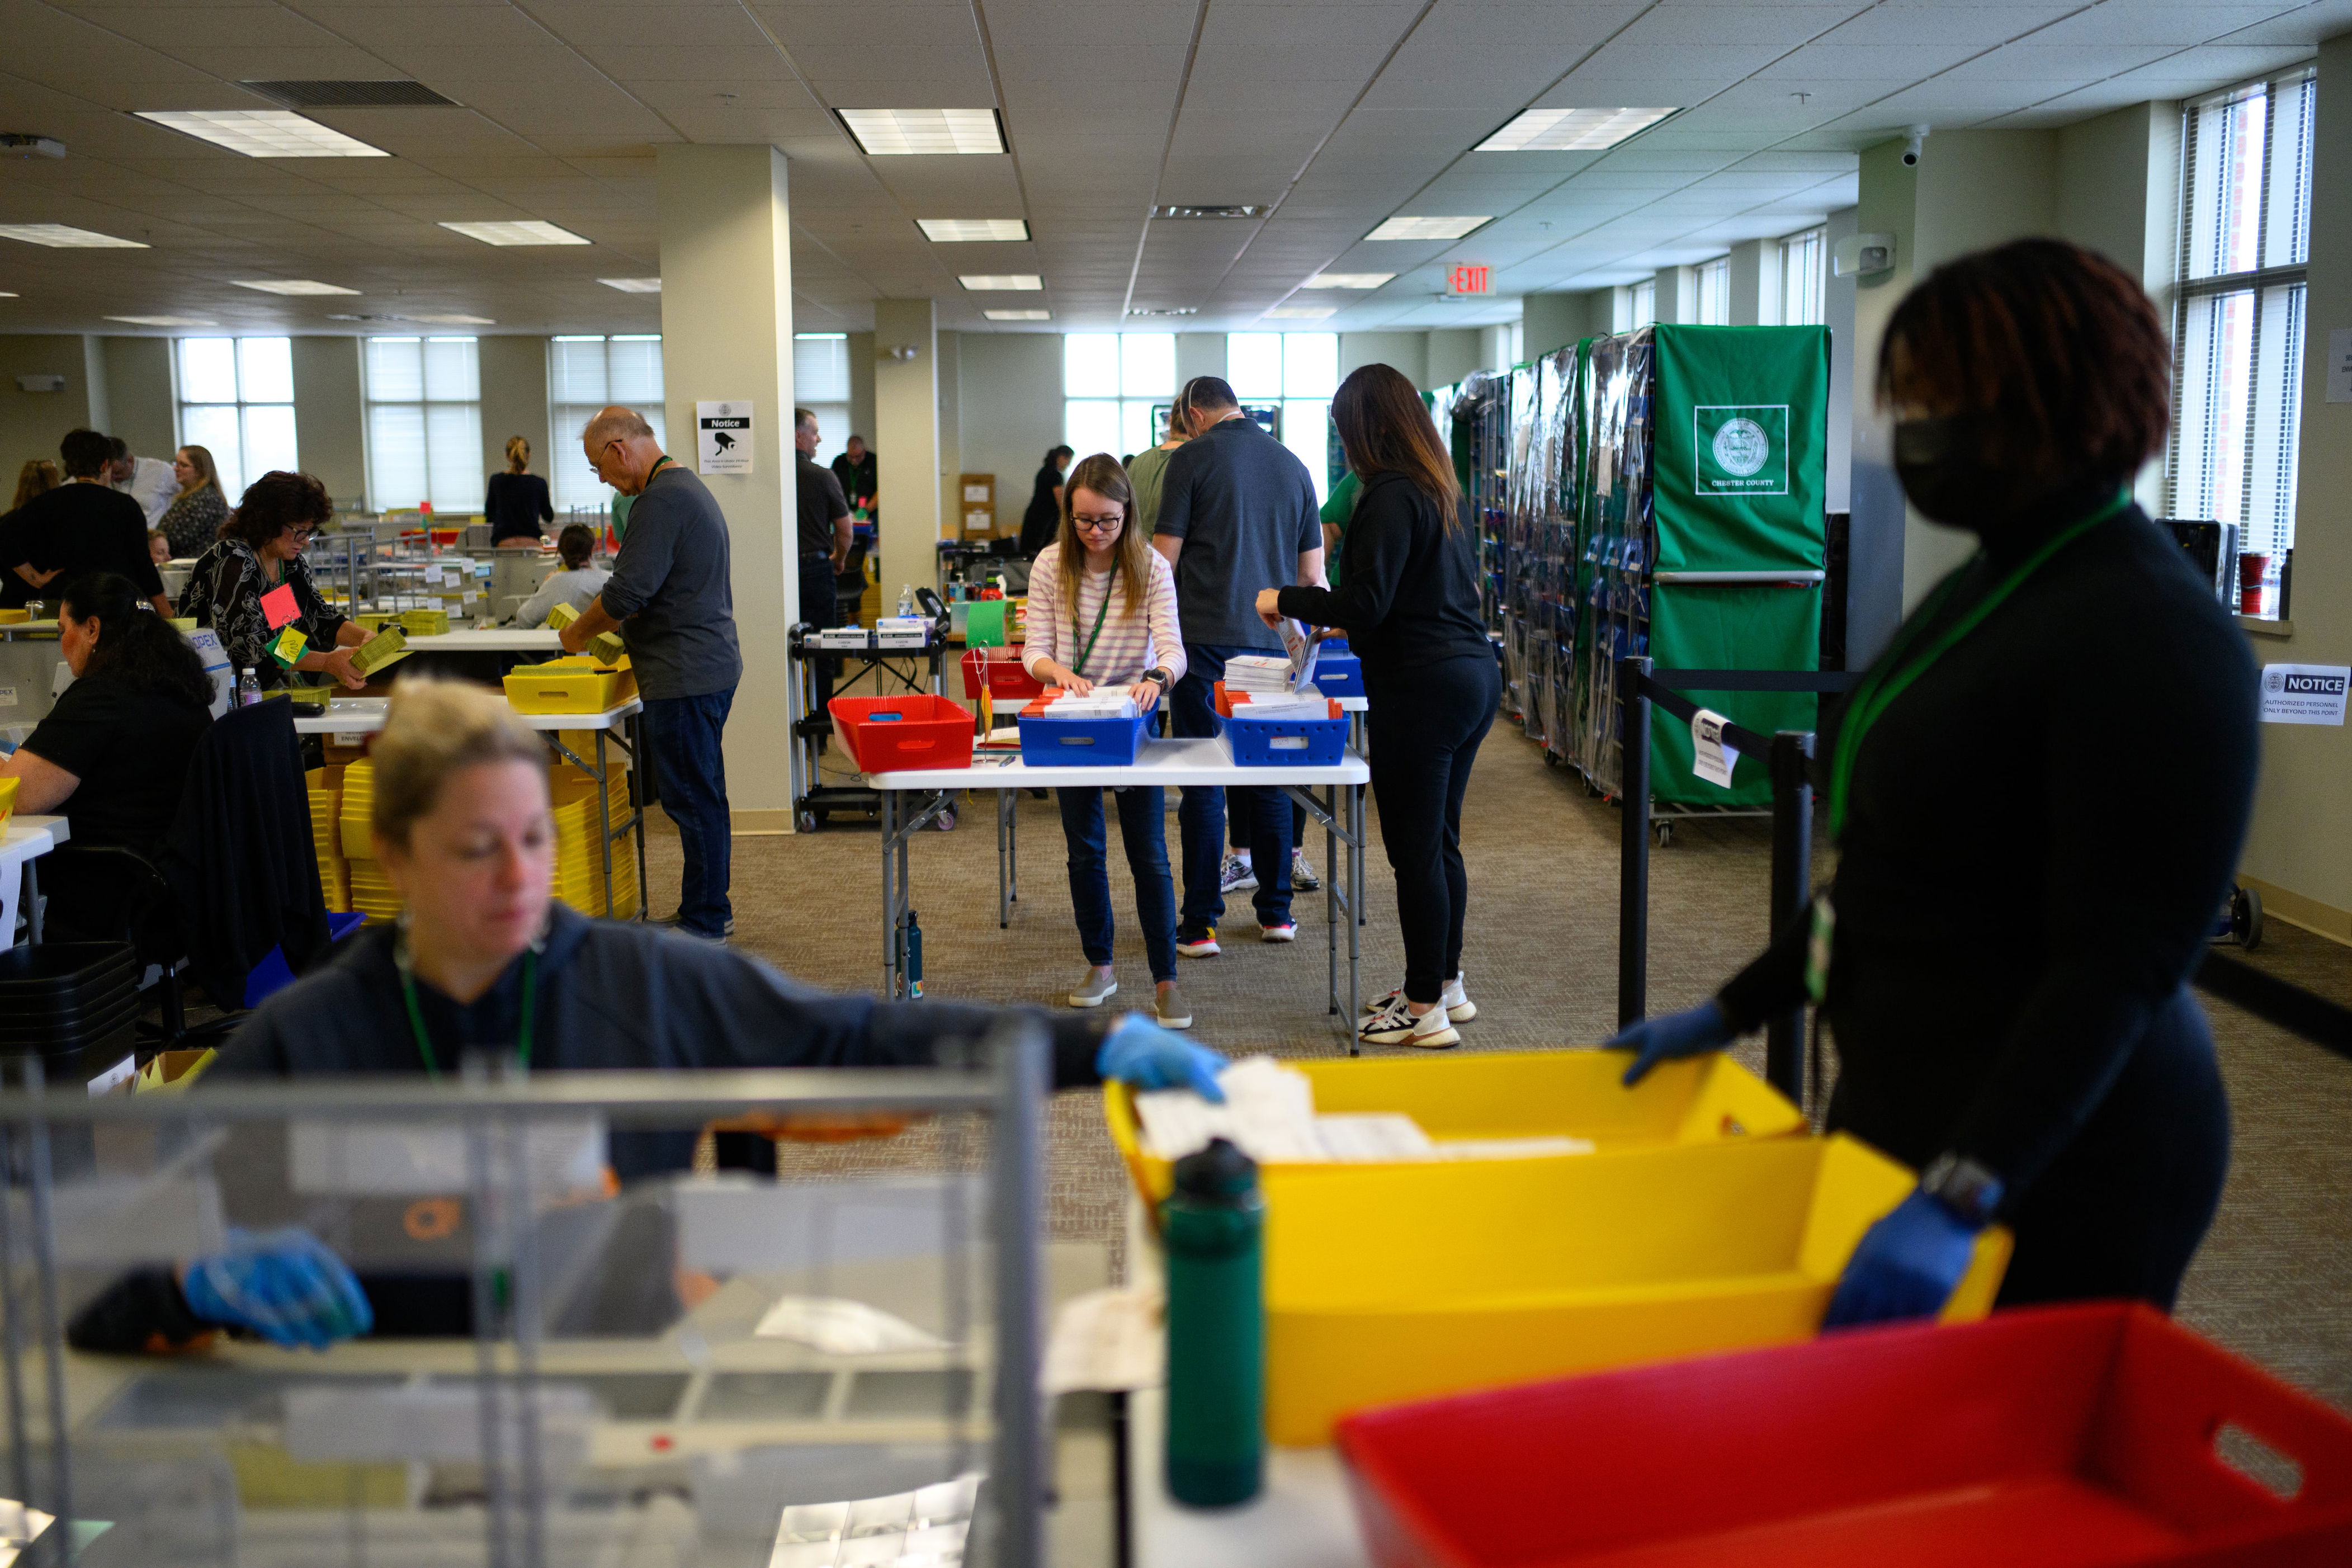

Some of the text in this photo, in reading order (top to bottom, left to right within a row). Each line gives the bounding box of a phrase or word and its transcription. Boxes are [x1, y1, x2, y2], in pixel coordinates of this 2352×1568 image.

[1456, 266, 1489, 292] EXIT
[192, 634, 218, 649] OPEX
[2288, 678, 2344, 691] NOTICE
